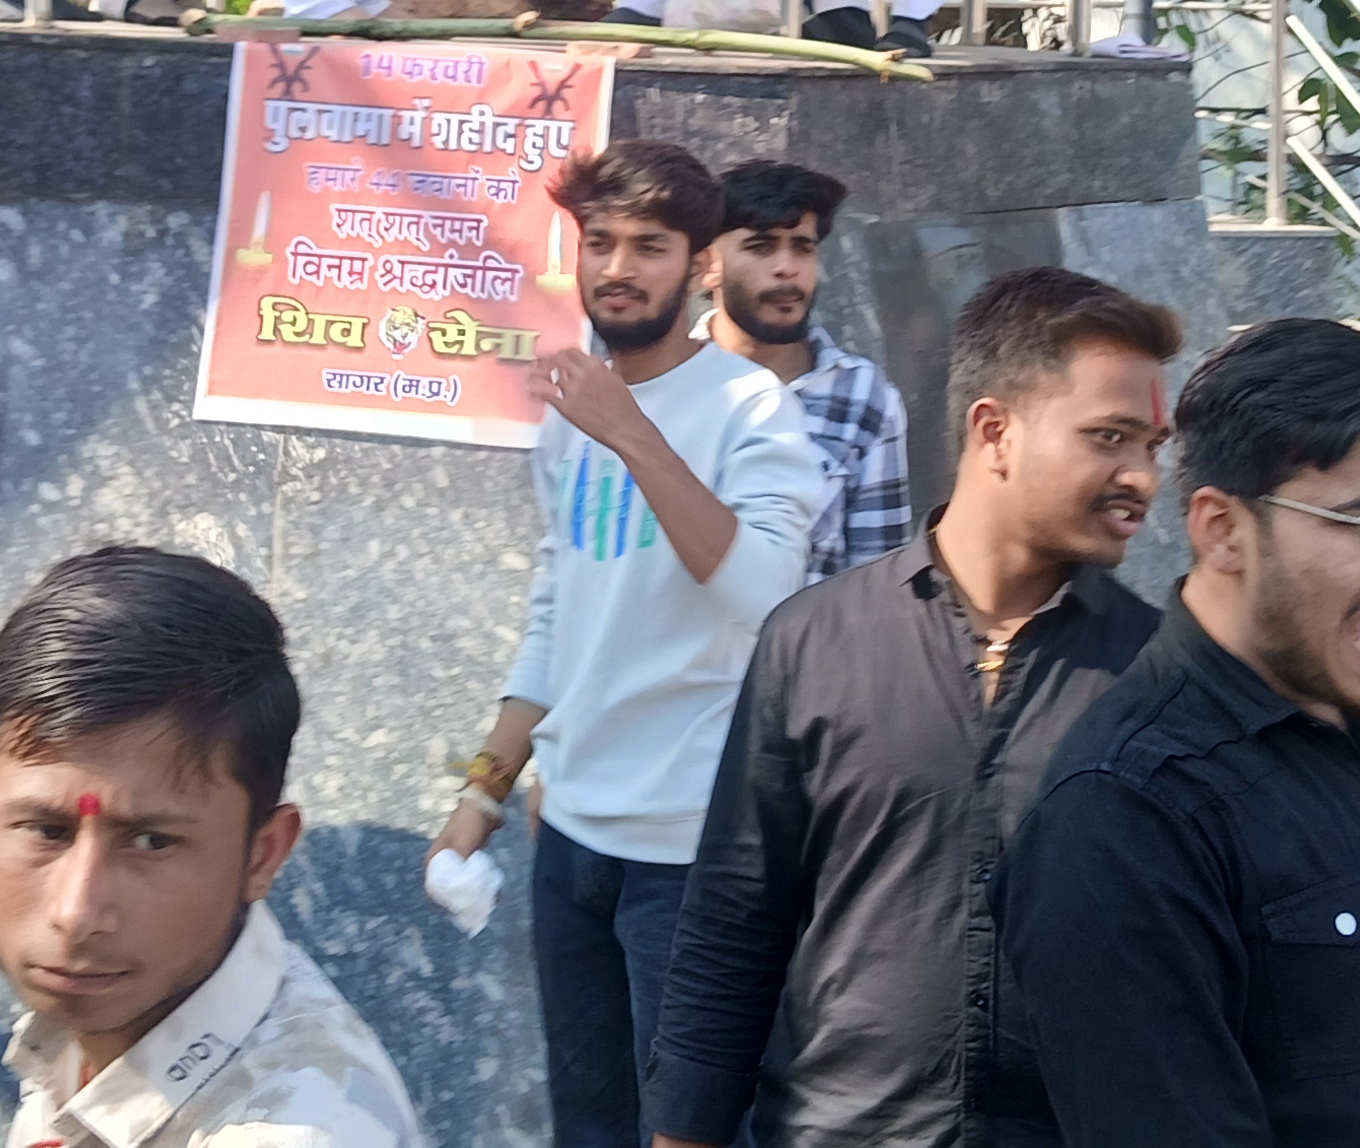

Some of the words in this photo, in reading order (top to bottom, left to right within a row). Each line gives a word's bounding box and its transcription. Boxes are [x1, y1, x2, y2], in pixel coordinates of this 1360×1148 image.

[360, 51, 394, 79] 14
[401, 52, 487, 86] फरवरी
[263, 98, 394, 153] पुलवामा
[397, 96, 433, 148] में
[431, 103, 522, 154] शहीद
[518, 116, 575, 172] हुए
[369, 169, 401, 194] 44
[485, 171, 521, 202] को
[428, 213, 486, 244] नमन
[290, 237, 371, 289] विनम्र
[378, 250, 521, 300] श्रद्धांजलि
[257, 296, 368, 347] शिव
[428, 309, 540, 360] सेना
[325, 371, 386, 395] सागर
